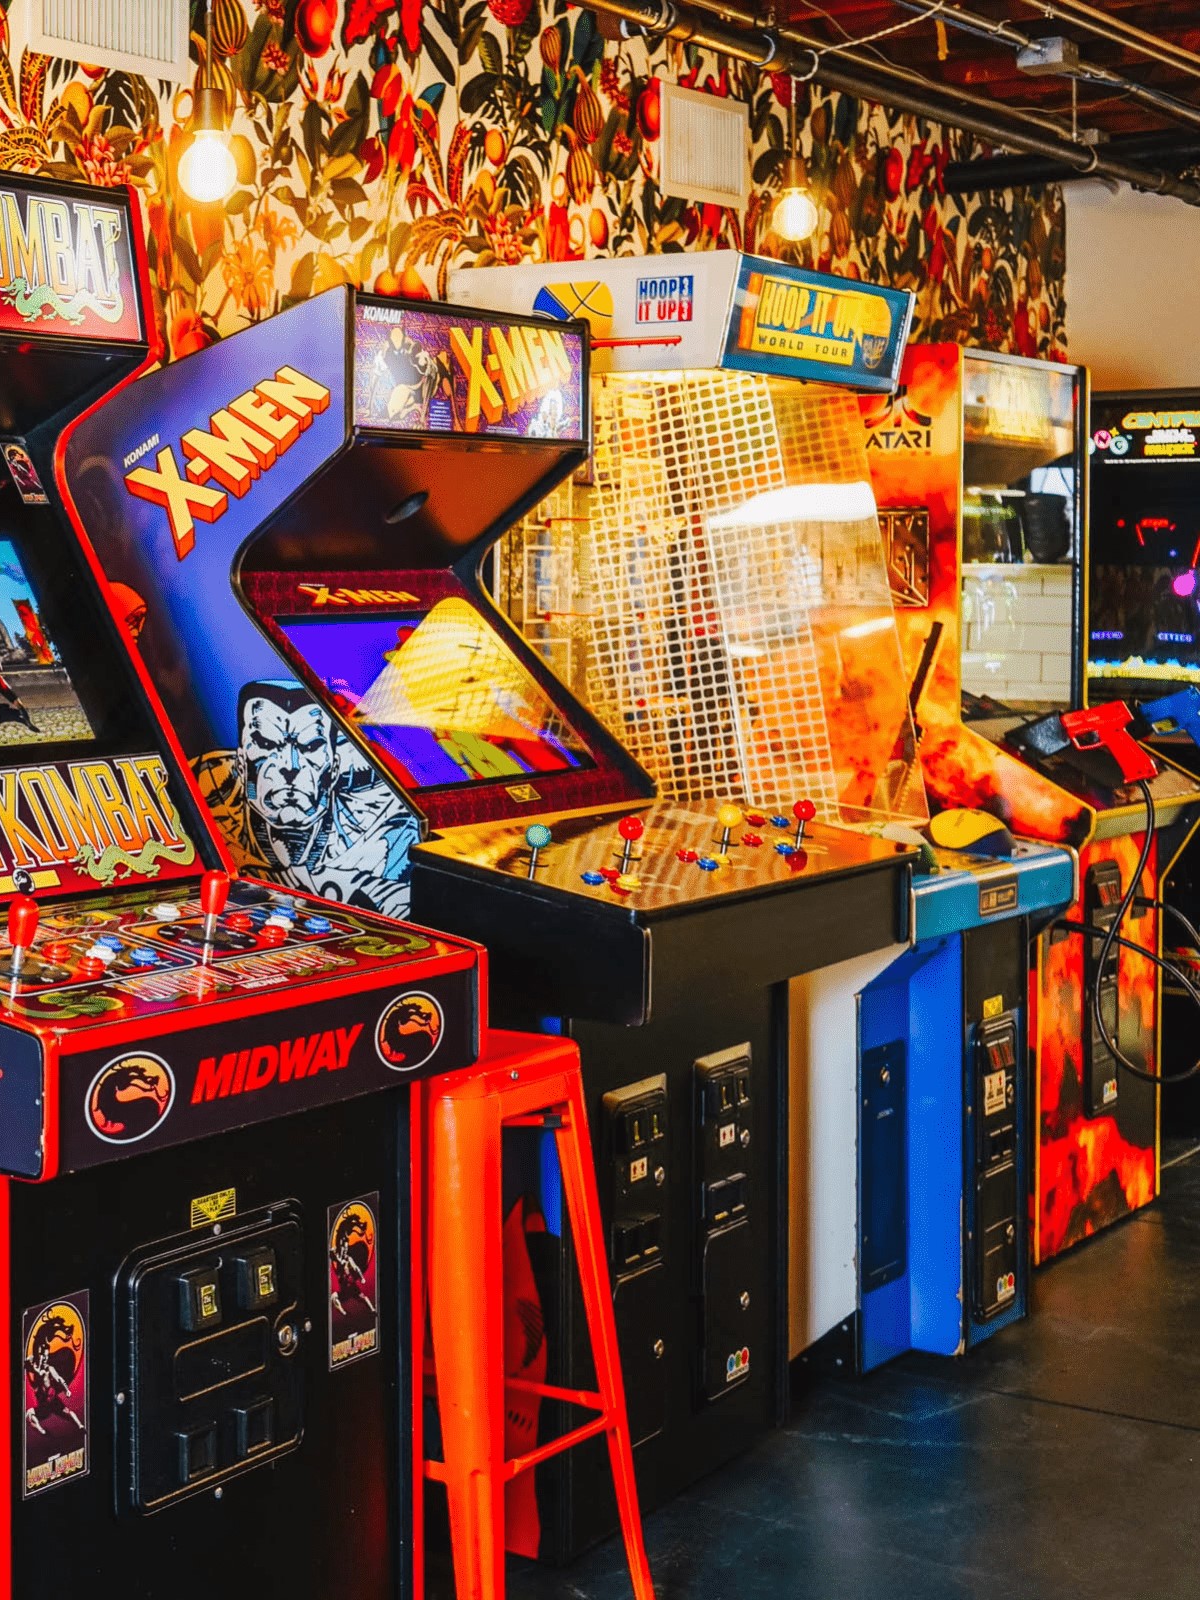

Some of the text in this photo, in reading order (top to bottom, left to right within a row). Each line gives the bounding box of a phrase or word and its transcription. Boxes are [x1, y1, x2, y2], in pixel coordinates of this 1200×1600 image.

[639, 279, 678, 299] HOOP
[363, 306, 402, 324] KONAMI
[638, 302, 651, 322] IT
[657, 301, 678, 321] UP
[758, 281, 810, 330] HOOP
[758, 335, 804, 351] WORLD
[815, 343, 849, 358] TOUR
[449, 325, 574, 432] X-MEN
[123, 433, 160, 468] KONAMI
[866, 430, 931, 449] ATARI
[125, 365, 331, 562] X-MEN
[297, 585, 421, 607] X-MEN
[242, 975, 290, 990] MIDWAY
[191, 1024, 365, 1106] MIDWAY
